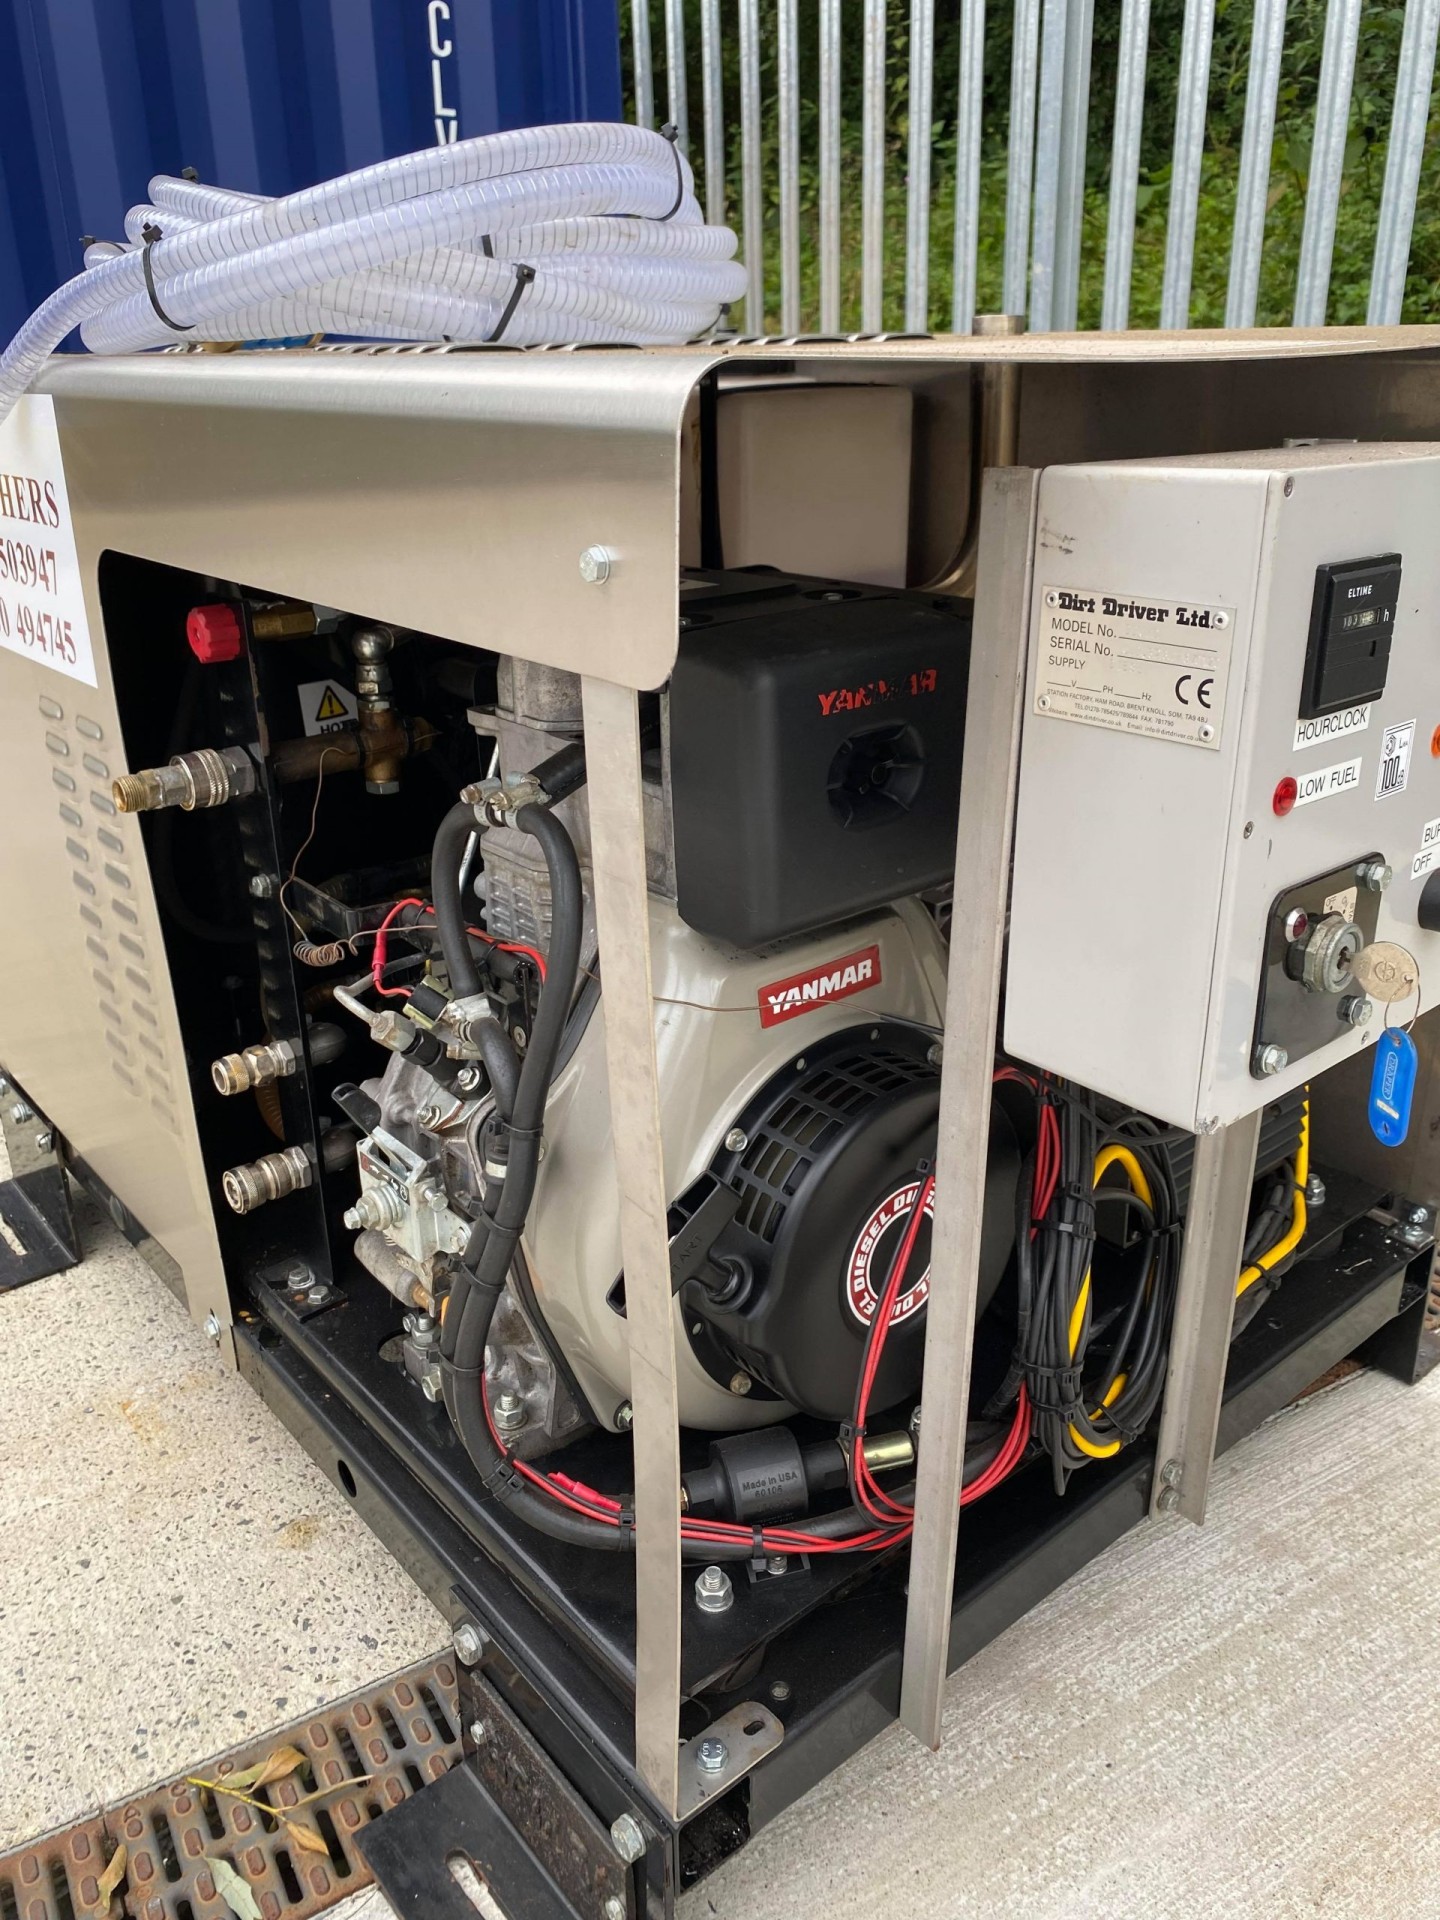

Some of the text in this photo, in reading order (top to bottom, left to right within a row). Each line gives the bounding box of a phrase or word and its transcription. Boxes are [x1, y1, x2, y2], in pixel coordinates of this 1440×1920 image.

[0, 473, 60, 528] HERS
[1347, 584, 1373, 599] ELTIME
[1051, 617, 1093, 636] MODEL
[1097, 623, 1117, 638] No.
[1058, 592, 1215, 629] Dirt Driver Ltd.
[16, 602, 77, 664] 494745
[1050, 636, 1114, 657] SERIAL No.
[1048, 655, 1086, 670] SUPPLY
[1046, 688, 1069, 699] STATION
[1102, 685, 1114, 695] PH
[1141, 692, 1152, 702] Hz
[1175, 674, 1214, 709] CE
[1297, 705, 1368, 743] HOURCLOCK
[1299, 764, 1357, 799] LOW FUEL
[1381, 755, 1400, 791] 100
[1413, 852, 1433, 873] OFF
[768, 958, 872, 1014] YANMAR
[853, 1212, 892, 1293] DIESEL
[742, 1479, 767, 1492] Made
[778, 1471, 798, 1483] USA
